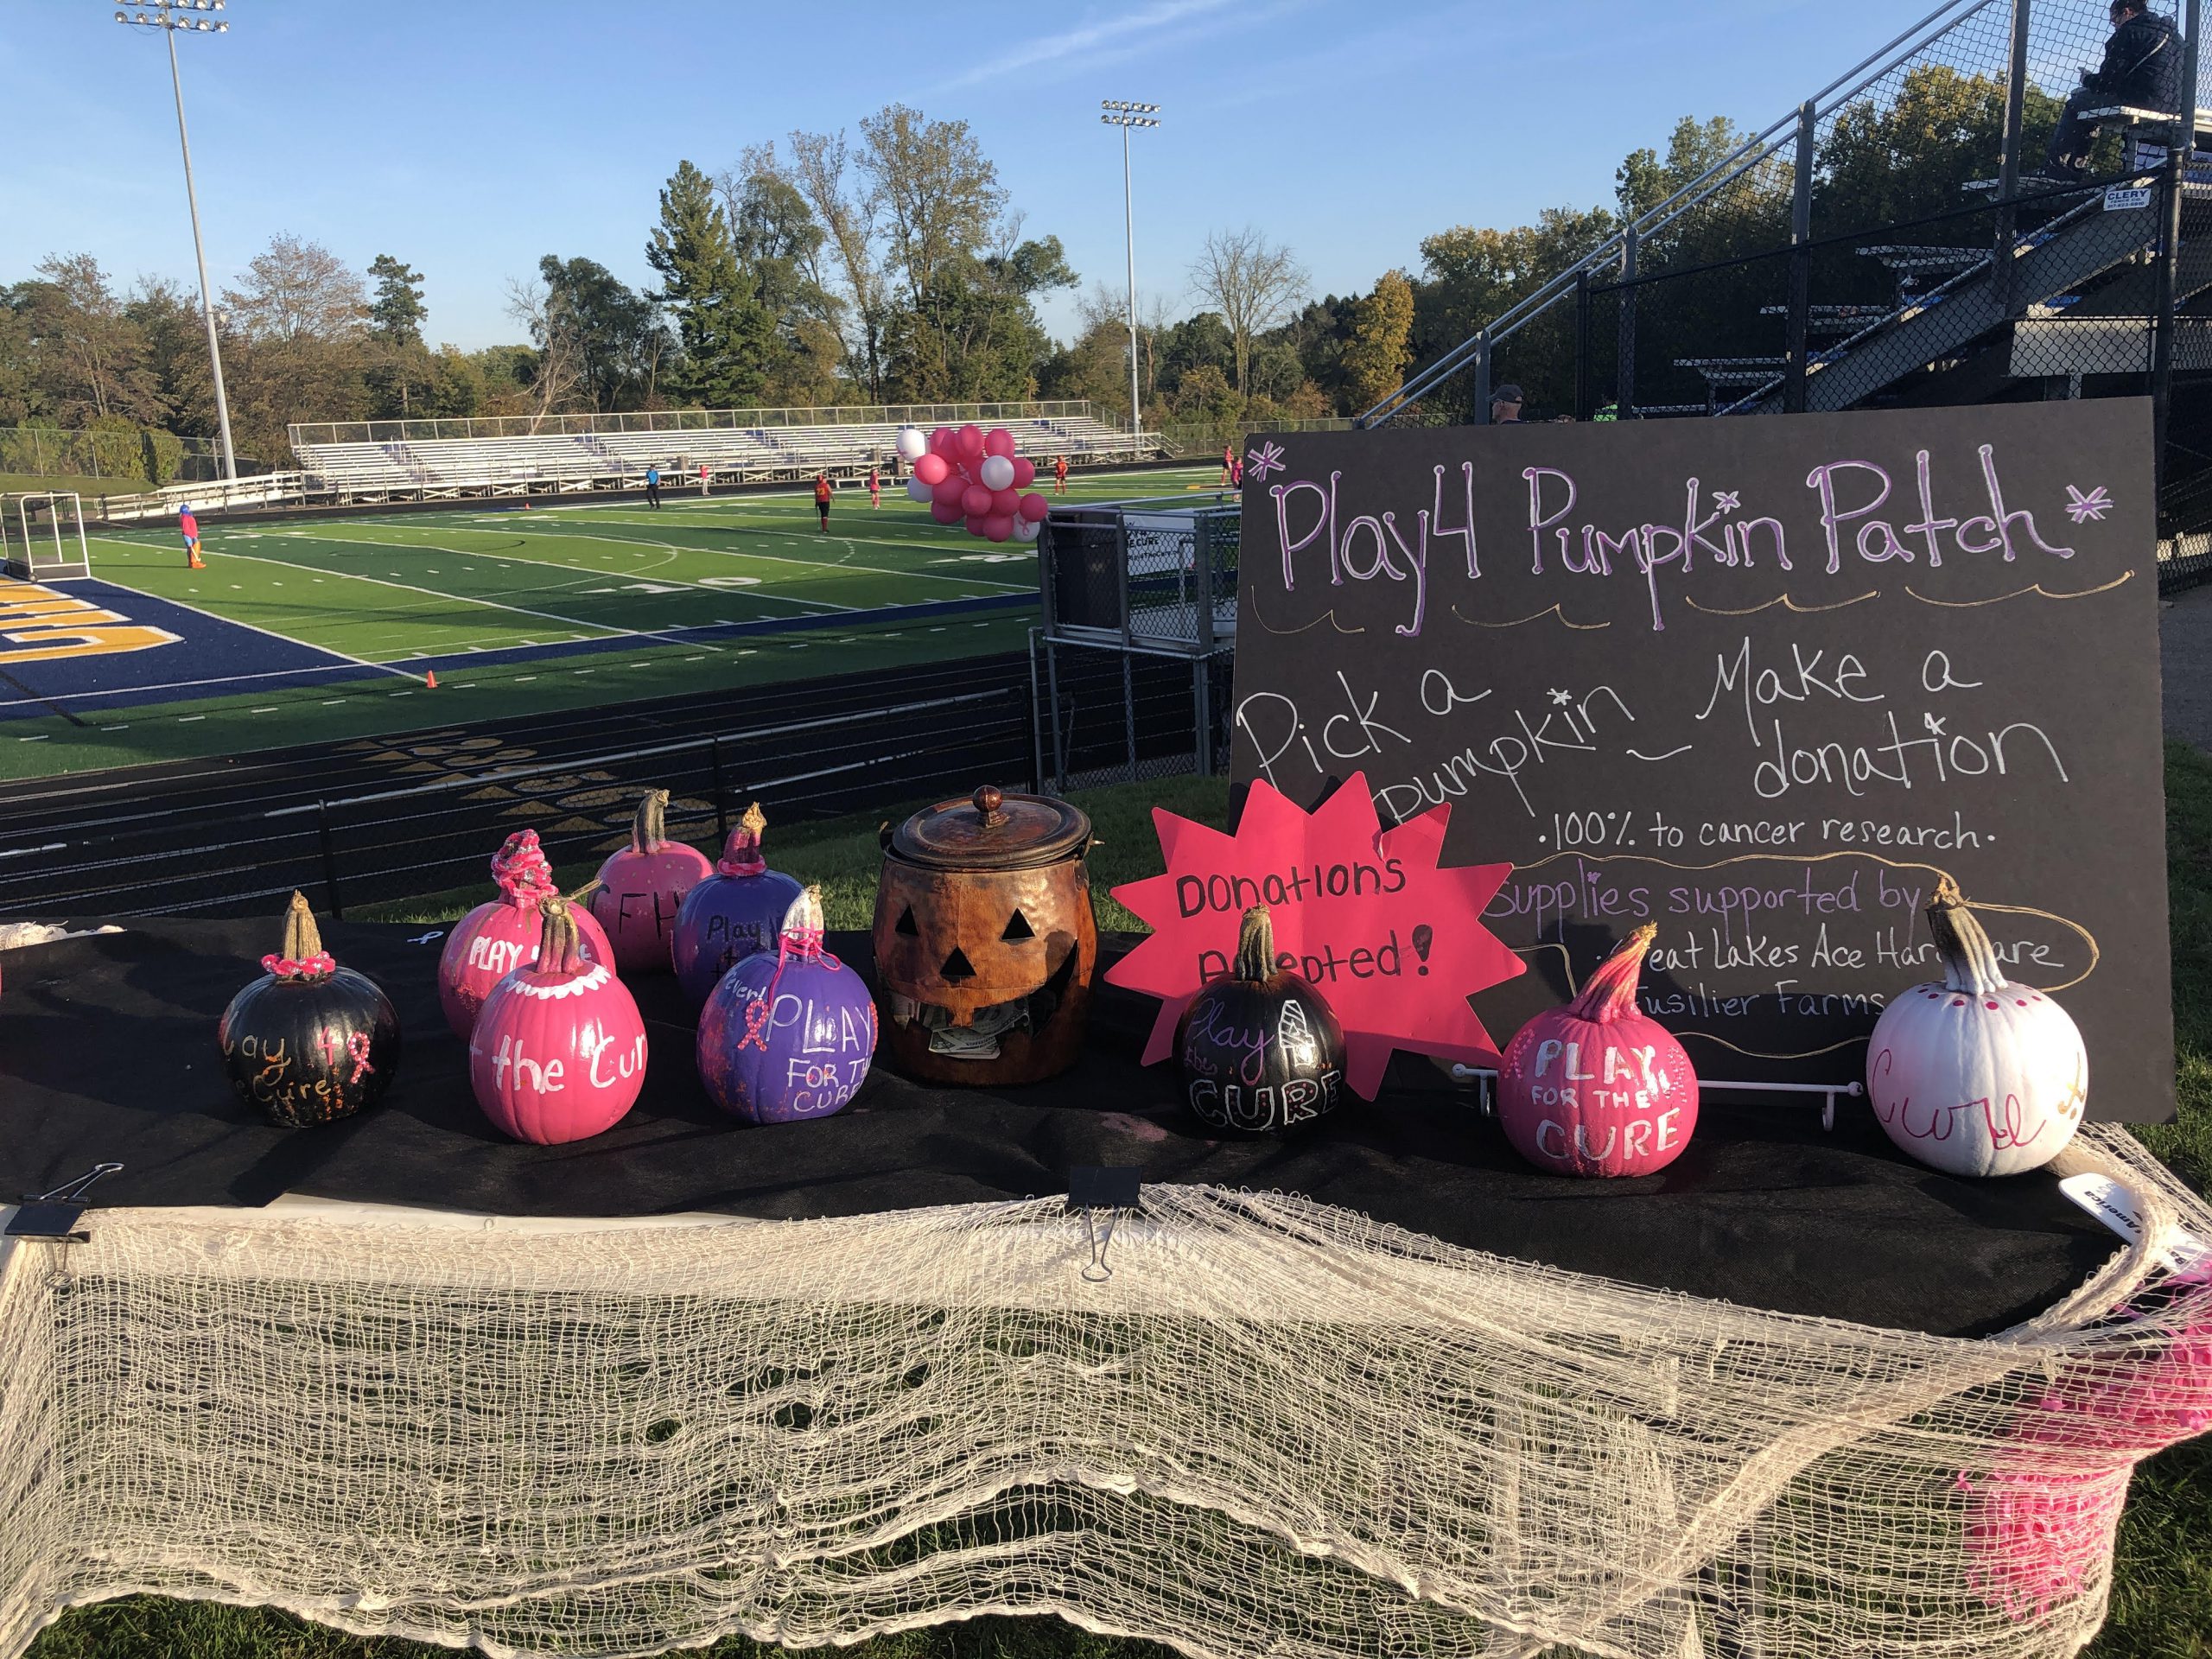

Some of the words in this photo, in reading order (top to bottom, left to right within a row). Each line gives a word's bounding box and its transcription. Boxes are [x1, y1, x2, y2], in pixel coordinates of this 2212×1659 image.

[2107, 189, 2148, 200] CLERY
[1522, 467, 1793, 632] Pumpkin
[1806, 444, 2075, 575] Patch
[1694, 636, 1885, 747] Make
[1922, 650, 1984, 693] a
[1236, 670, 1412, 793] Pick
[1421, 669, 1492, 715] a
[1371, 685, 1636, 818] pumpkin
[1754, 710, 2069, 798] donation
[1648, 812, 1684, 848] to
[1698, 821, 1806, 845] cancer
[1668, 867, 1861, 947] supported
[1878, 868, 1922, 946] by
[468, 935, 524, 974] PLAY
[1198, 925, 1433, 988] Aepted!
[1712, 927, 1799, 969] Lakes
[1811, 922, 1866, 969] Ace
[766, 994, 872, 1056] PLAY
[1775, 979, 1885, 1017] Farms
[491, 1034, 565, 1095] the
[787, 1057, 839, 1089] FOR
[1535, 1039, 1657, 1088] PLAY
[1189, 1070, 1342, 1132] CURE
[1530, 1085, 1580, 1109] FOR
[1592, 1090, 1651, 1109] THE
[1535, 1107, 1681, 1161] CURE
